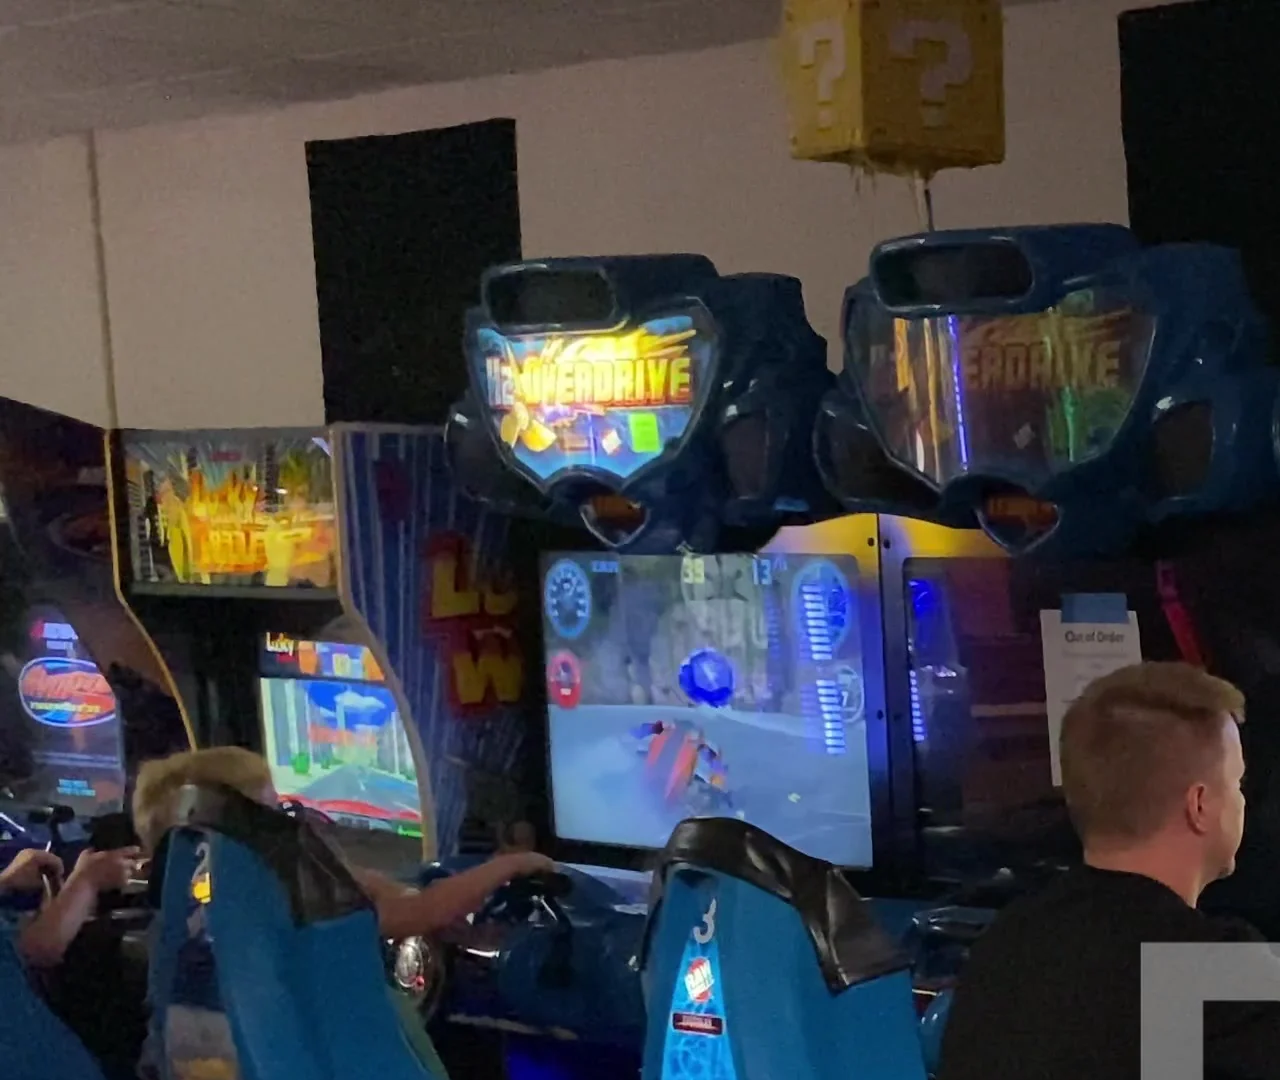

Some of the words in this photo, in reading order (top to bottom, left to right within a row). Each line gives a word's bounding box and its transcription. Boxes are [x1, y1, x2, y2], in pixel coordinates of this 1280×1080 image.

[1064, 630, 1084, 643] Out
[1085, 630, 1096, 643] of
[1097, 631, 1126, 644] Order
